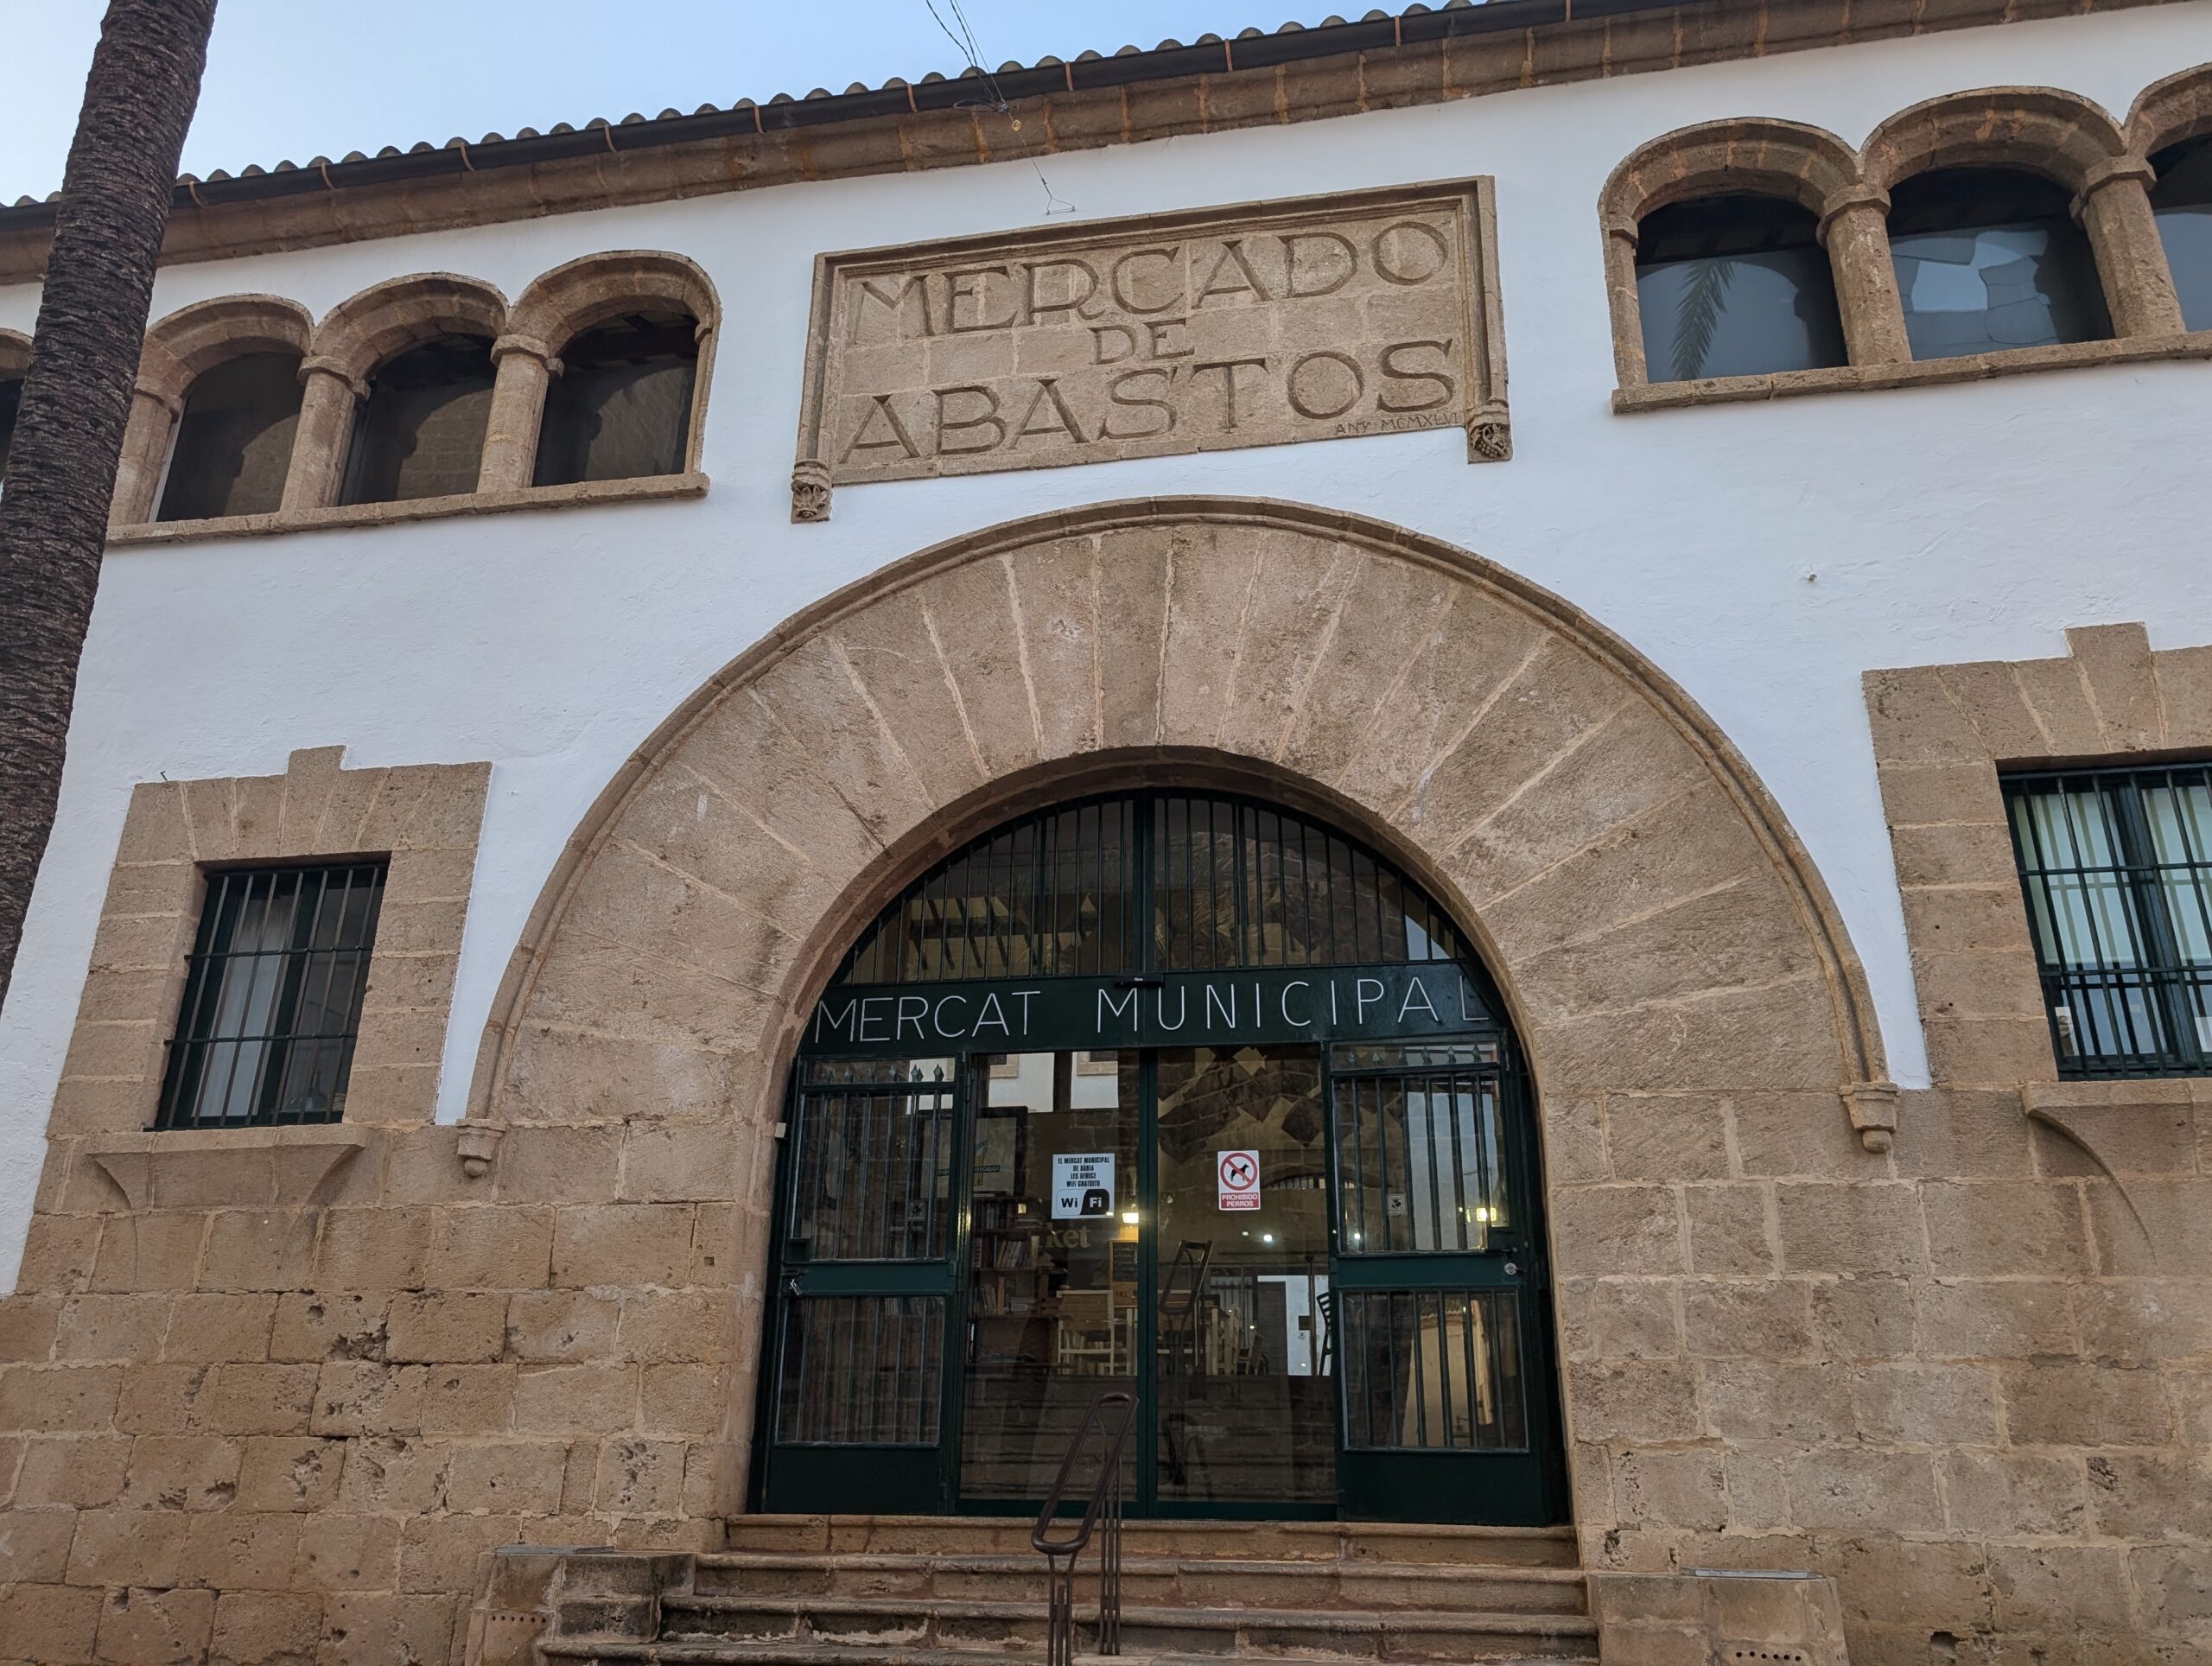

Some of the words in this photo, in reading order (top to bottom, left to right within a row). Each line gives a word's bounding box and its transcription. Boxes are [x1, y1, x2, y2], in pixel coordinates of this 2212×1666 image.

[847, 222, 1450, 345] MERCADO
[1089, 317, 1196, 366] DE
[841, 338, 1456, 462] ABASTOS
[1336, 421, 1370, 435] ANY
[1380, 412, 1459, 431] MCMXLVI
[814, 989, 1042, 1045] MERCAT
[1096, 976, 1491, 1033] MUNICIPAL
[1061, 1198, 1078, 1208] Wi
[1089, 1197, 1102, 1208] Fi
